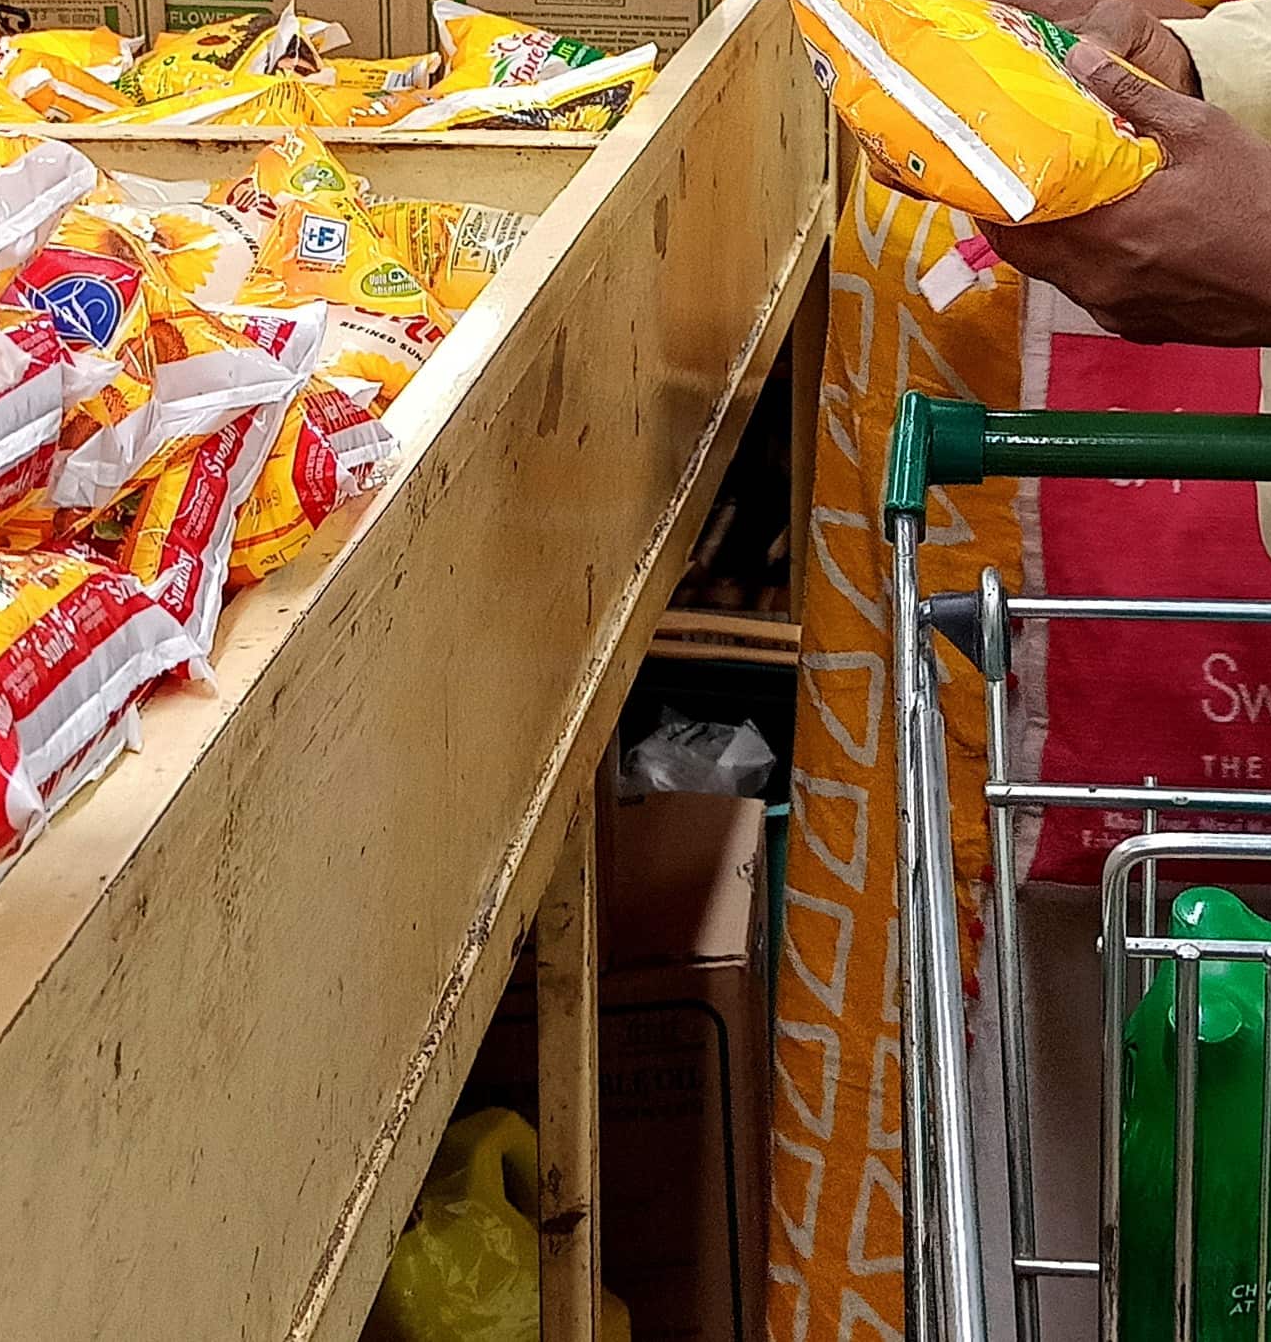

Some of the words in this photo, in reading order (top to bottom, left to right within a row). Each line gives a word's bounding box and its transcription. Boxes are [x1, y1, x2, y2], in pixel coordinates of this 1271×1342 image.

[339, 321, 397, 346] REFINED
[1202, 755, 1264, 780] THE
[1229, 1299, 1255, 1316] AT
